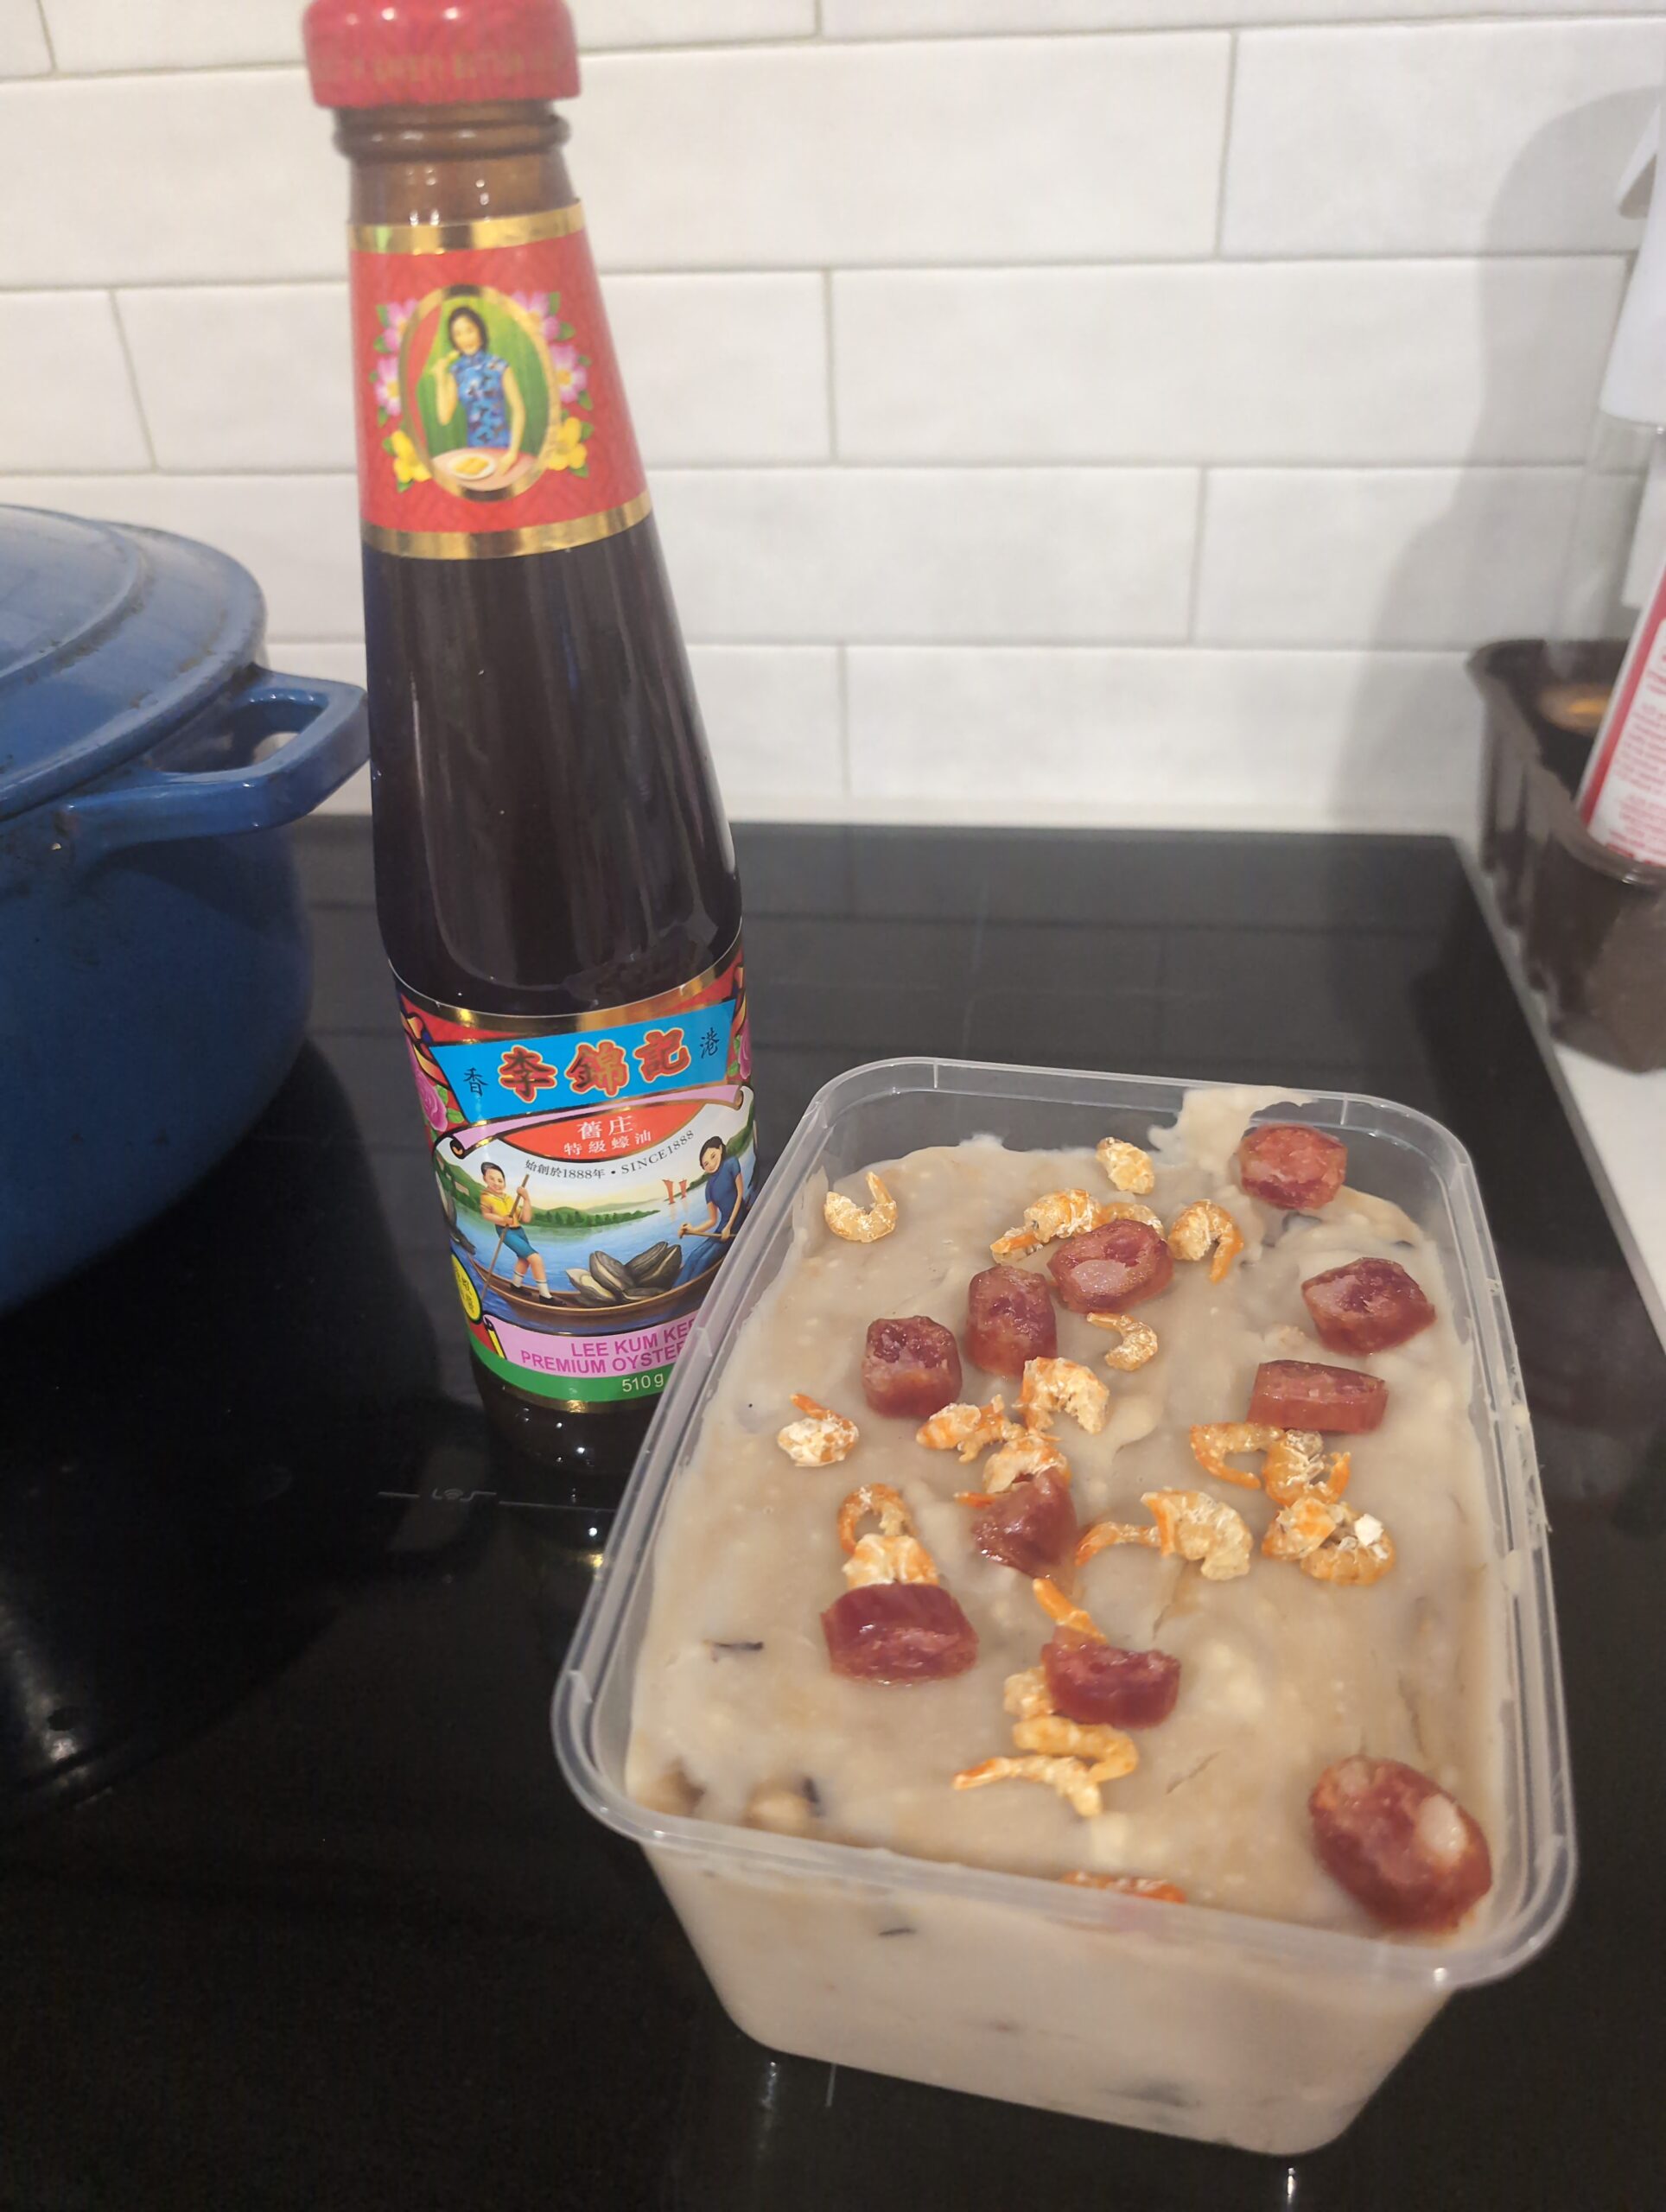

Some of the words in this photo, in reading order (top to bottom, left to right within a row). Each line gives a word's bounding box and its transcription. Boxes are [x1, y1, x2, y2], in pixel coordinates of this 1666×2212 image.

[498, 1028, 690, 1103] 李錦記
[577, 1116, 634, 1141] 舊庄
[563, 1130, 652, 1156] 特級蠔油
[570, 1343, 608, 1357] LEE
[614, 1333, 658, 1355] KUM
[520, 1350, 607, 1374] PREMIUM
[621, 1376, 651, 1393] 510
[654, 1373, 664, 1388] g
